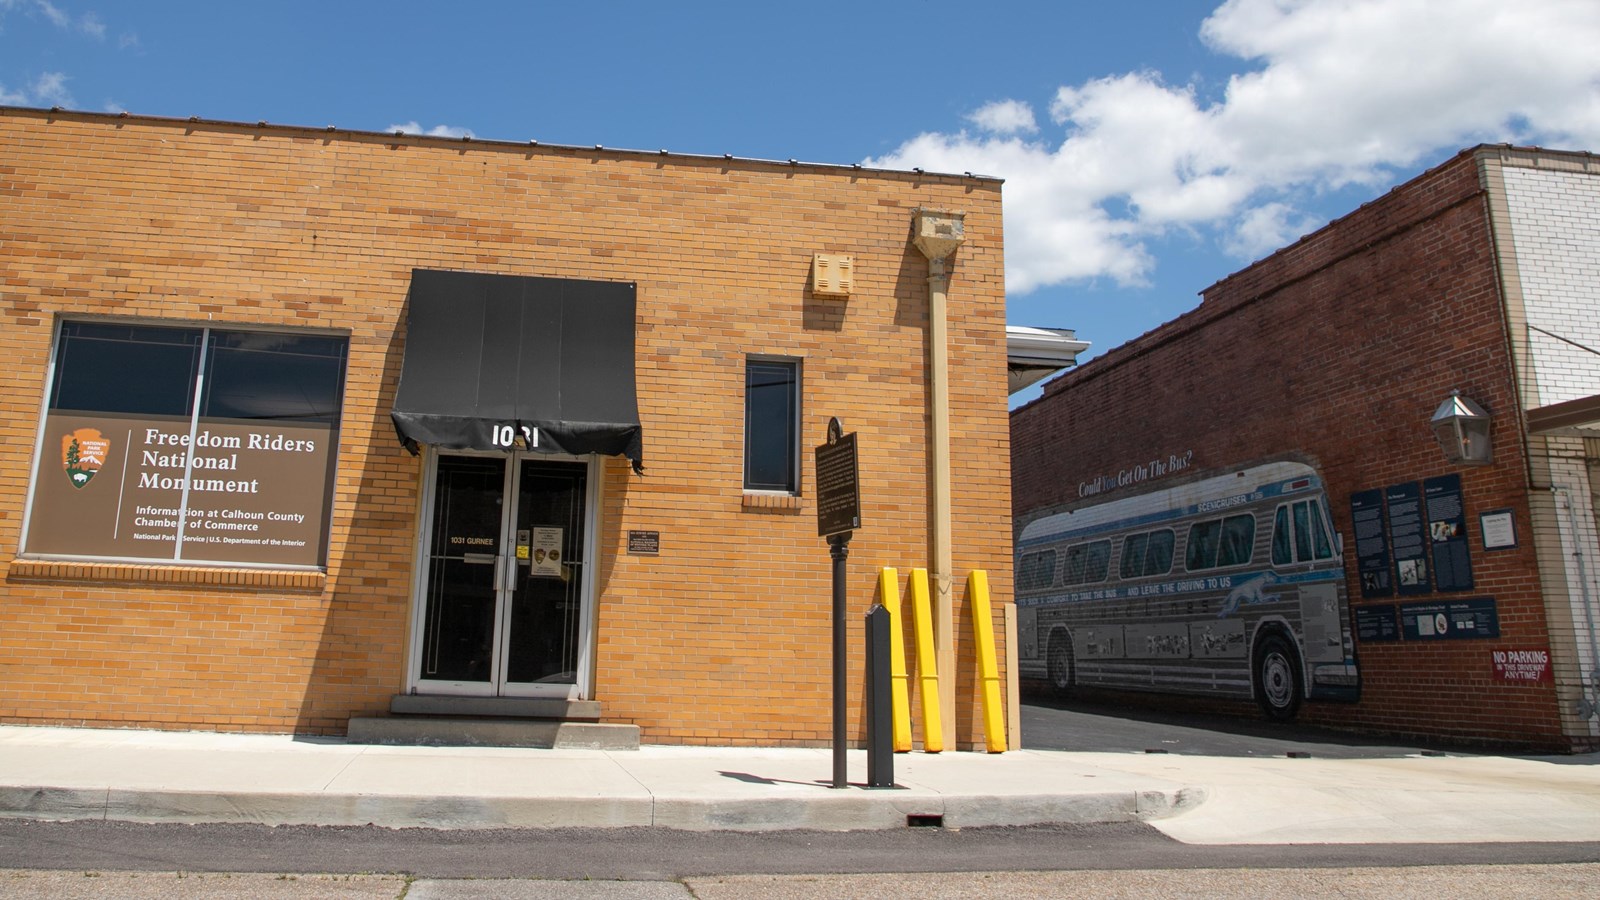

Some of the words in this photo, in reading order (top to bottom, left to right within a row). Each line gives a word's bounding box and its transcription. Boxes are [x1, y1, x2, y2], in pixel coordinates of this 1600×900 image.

[144, 428, 241, 449] Freedom
[247, 433, 315, 452] Riders
[141, 450, 237, 470] National
[1078, 477, 1101, 498] Could
[1102, 475, 1116, 491] You
[1118, 470, 1132, 487] Get
[1134, 464, 1147, 482] On
[1149, 460, 1167, 478] The
[1169, 450, 1192, 472] Bus?
[138, 472, 258, 493] Monument
[208, 509, 218, 518] at
[221, 509, 264, 520] Calhoun
[267, 511, 305, 524] County
[190, 520, 202, 529] of
[204, 520, 258, 531] Commerce
[134, 533, 160, 541] National
[223, 537, 260, 545] Department
[450, 536, 465, 544] 1031
[466, 537, 494, 546] GURNEE
[1071, 593, 1079, 601] TO
[1094, 591, 1104, 599] THE
[1128, 587, 1139, 596] AND
[1141, 584, 1159, 595] LEAVE
[1162, 583, 1175, 593] THE
[1177, 579, 1205, 592] DRIVING
[1208, 578, 1217, 588] TO
[1220, 576, 1231, 587] US
[1493, 651, 1506, 663] NO
[1508, 650, 1548, 663] PARKING
[1505, 670, 1541, 680] ANYTIME!
[1518, 664, 1545, 672] DRIVEWAY
